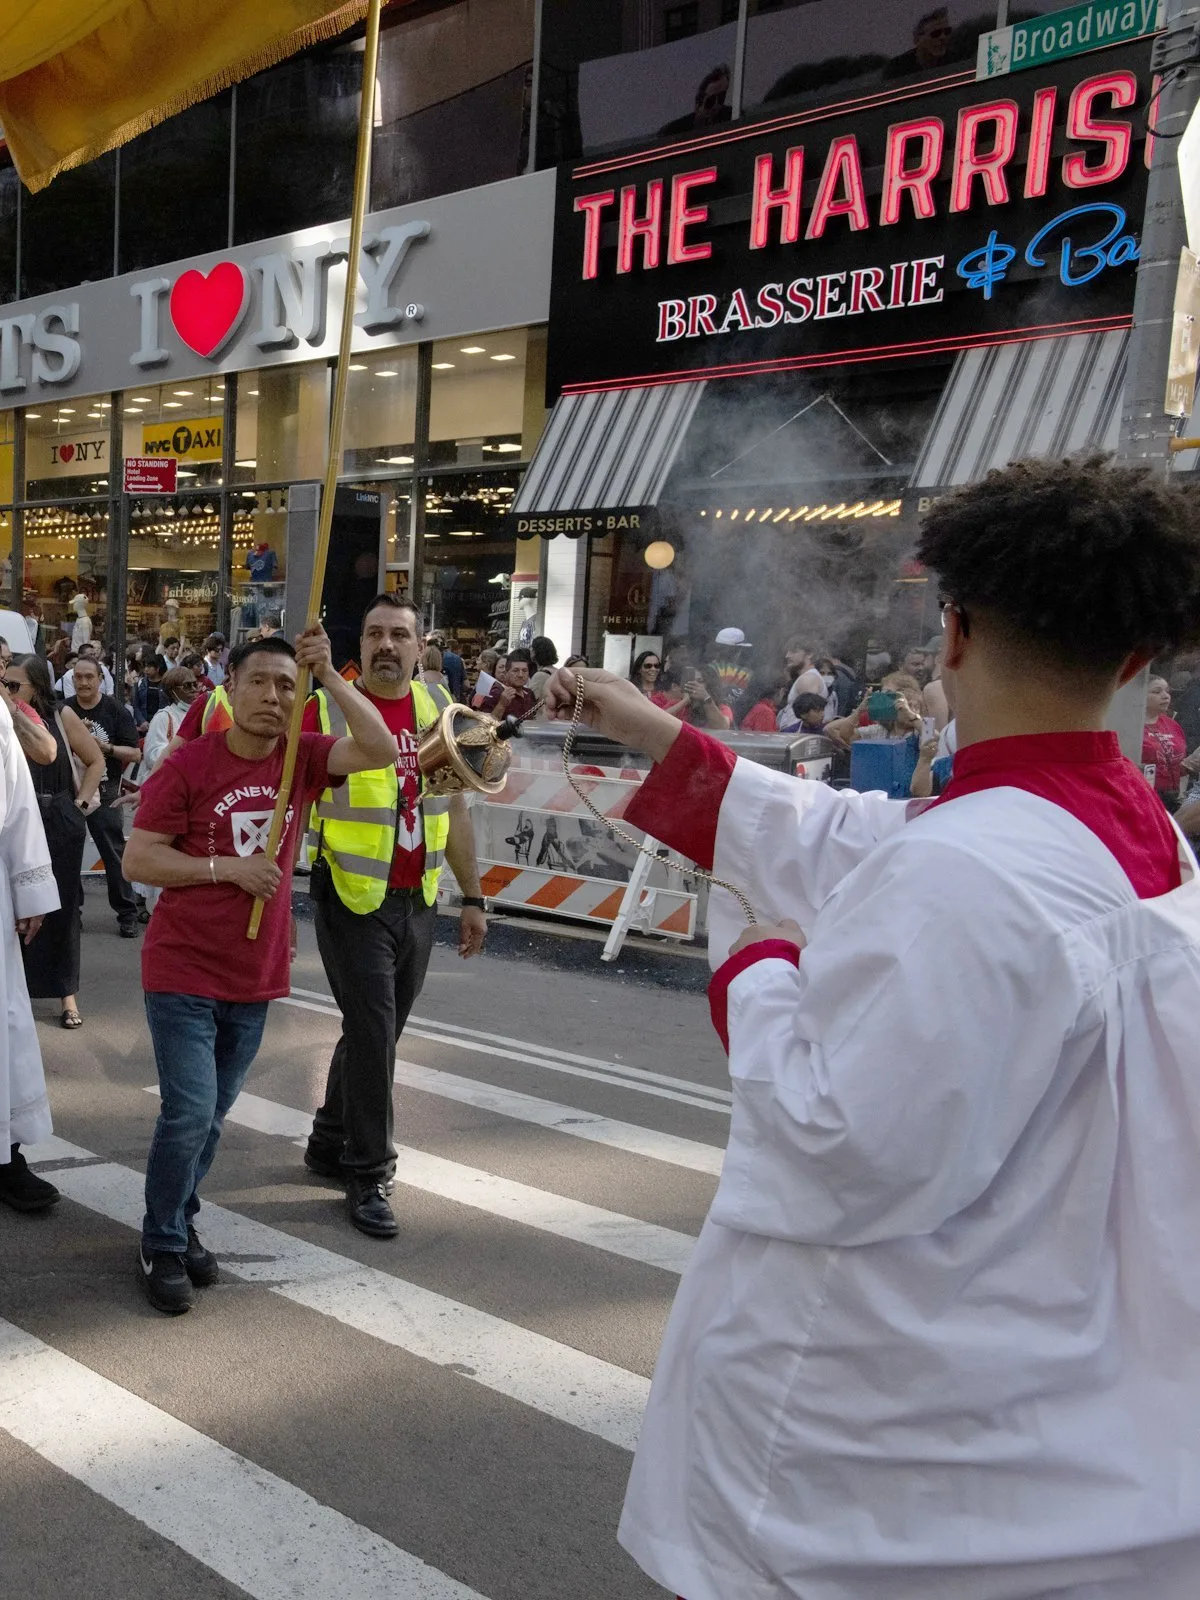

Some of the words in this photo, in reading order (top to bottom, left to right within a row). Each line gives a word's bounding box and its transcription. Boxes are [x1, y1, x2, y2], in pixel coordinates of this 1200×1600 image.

[1012, 0, 1153, 62] Broadway
[574, 168, 718, 281] THE
[656, 255, 945, 343] BRASSERIE
[1025, 202, 1142, 287] Ba
[130, 278, 171, 368] I
[250, 220, 432, 348] NY
[51, 446, 59, 464] I
[75, 440, 105, 462] NY
[144, 439, 171, 454] NYC
[174, 427, 221, 453] TAXI
[127, 460, 137, 468] NO
[138, 460, 169, 468] STANDING
[127, 475, 145, 483] Loading
[356, 492, 379, 504] LinkNYC
[517, 516, 593, 533] DESSERTS
[606, 514, 641, 530] BAR
[602, 615, 621, 624] THE
